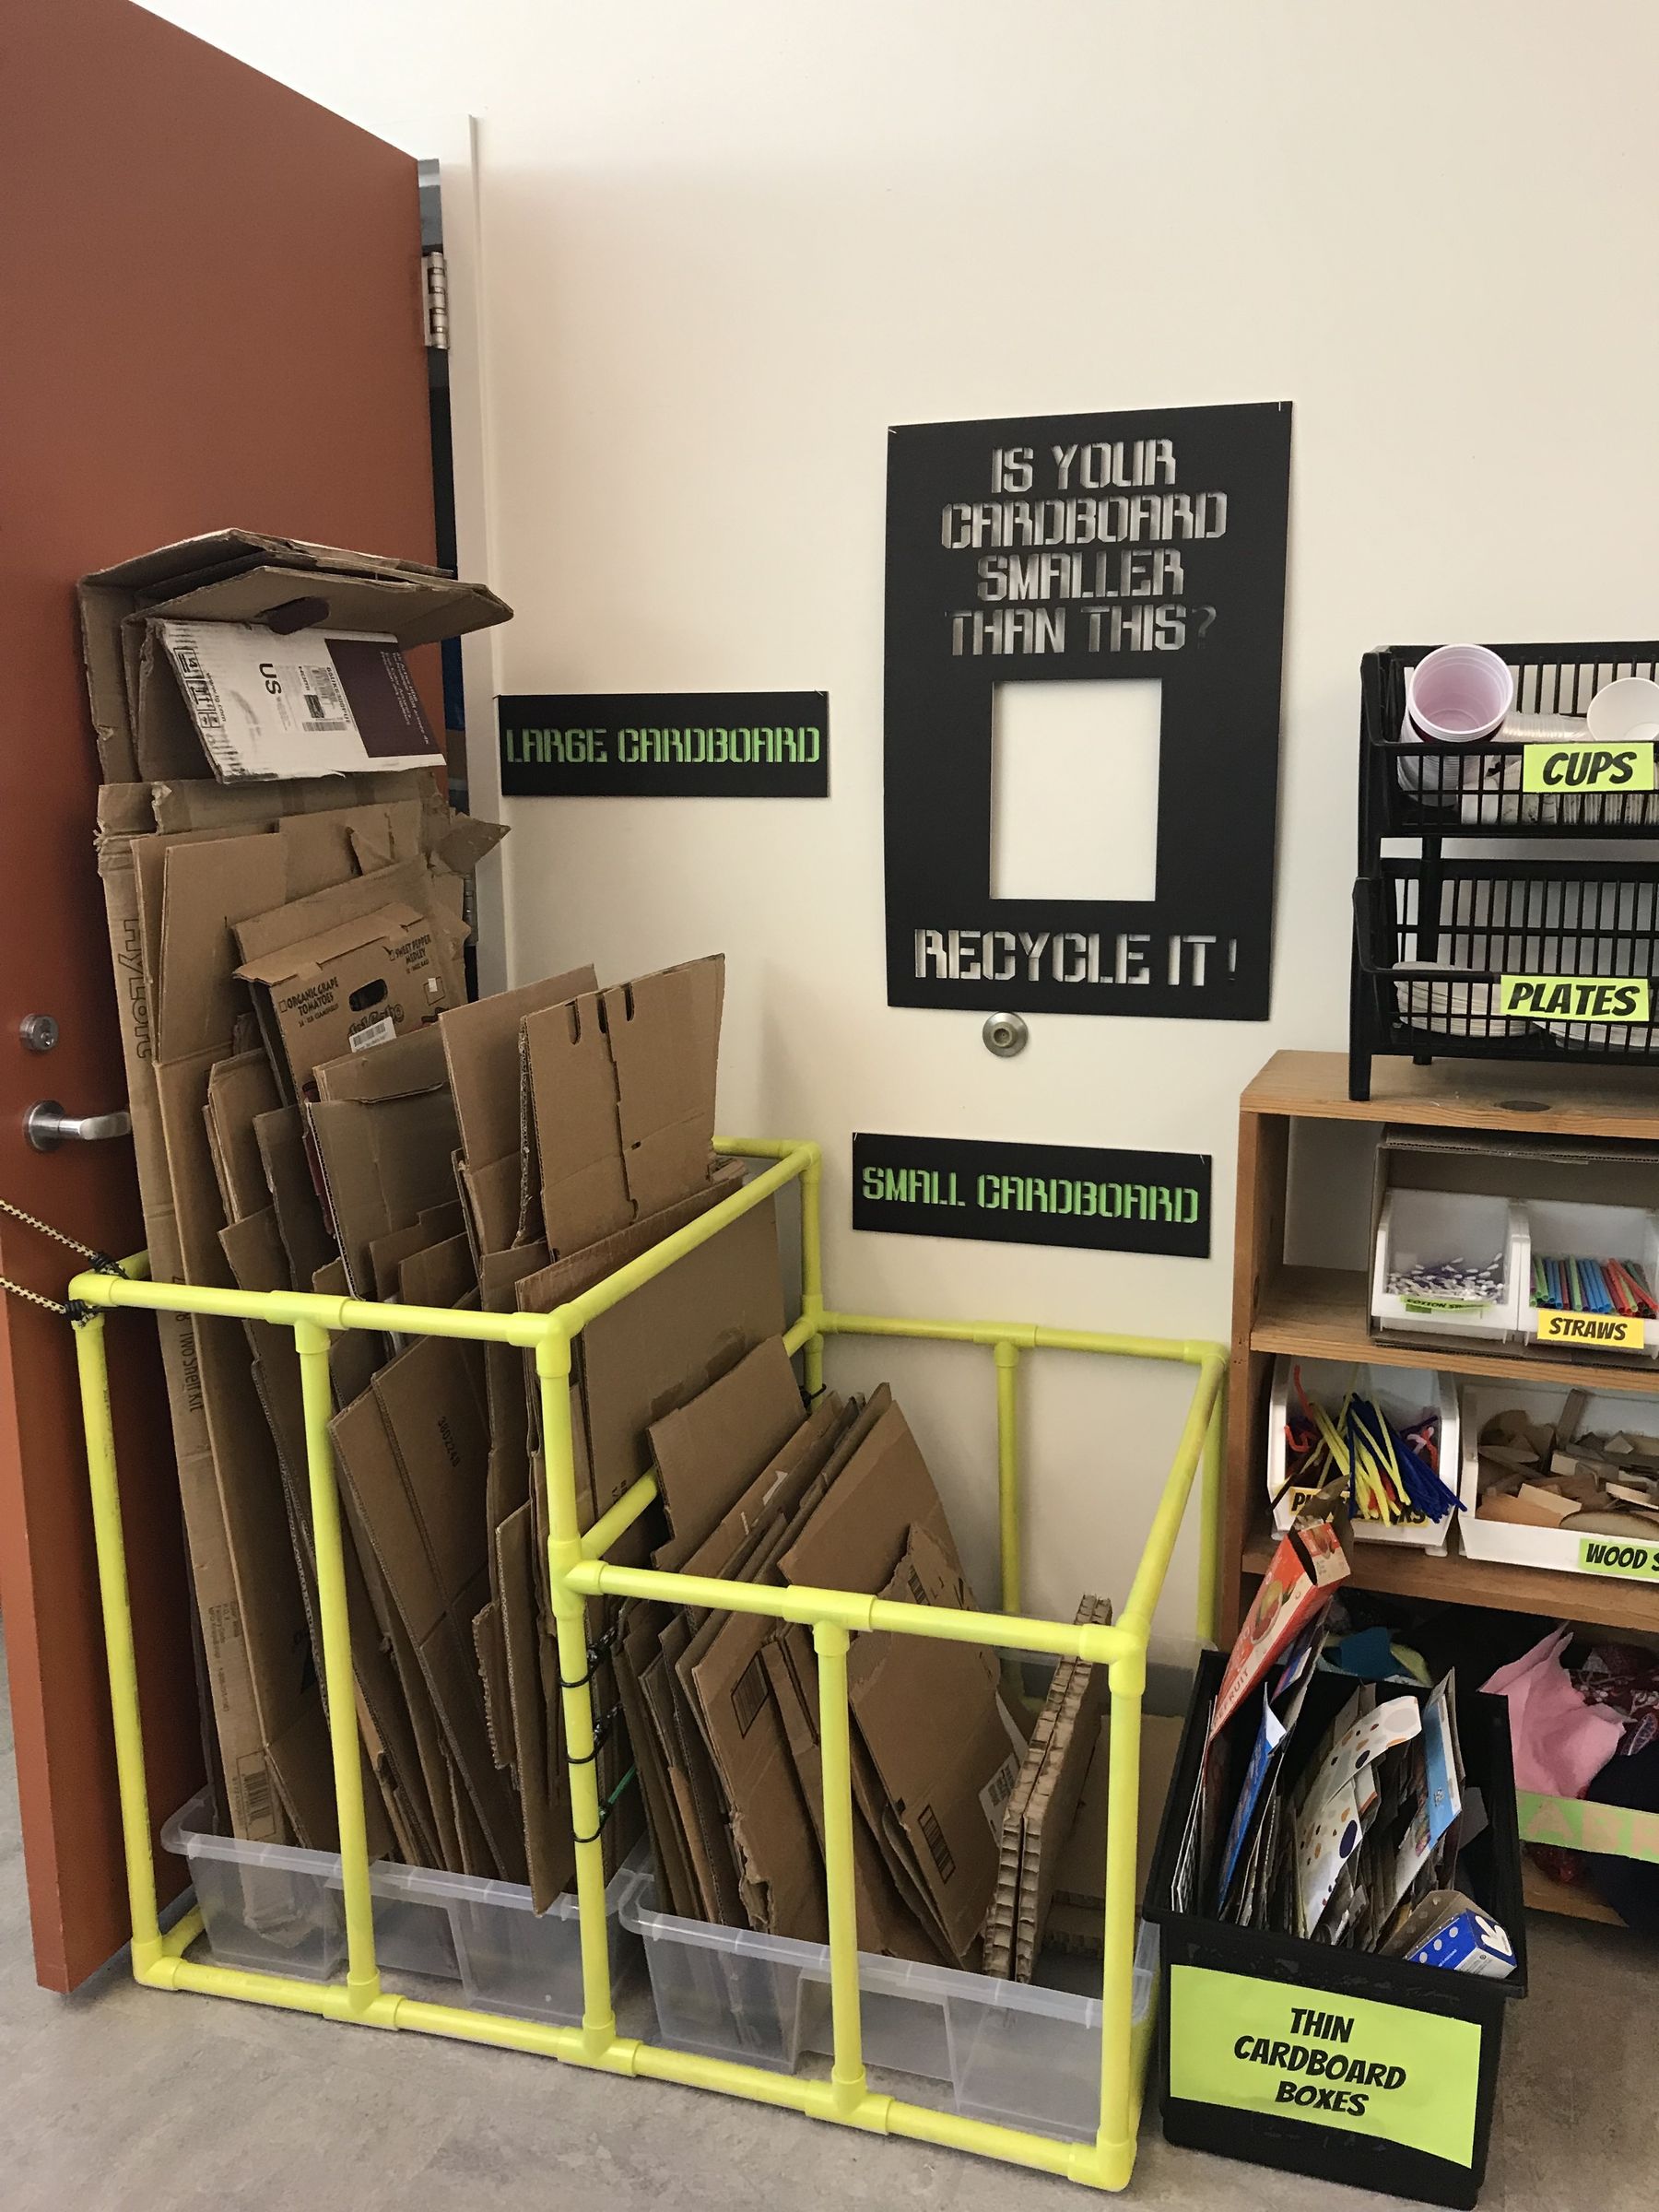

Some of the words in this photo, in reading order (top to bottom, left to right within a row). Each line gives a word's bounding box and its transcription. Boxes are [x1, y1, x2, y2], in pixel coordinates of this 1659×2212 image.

[991, 447, 1033, 493] IS
[1051, 439, 1176, 489] YOUR
[941, 491, 1228, 549] CARDBOARD
[977, 547, 1184, 602] SMALLER
[946, 606, 1066, 656] THAN
[1081, 604, 1218, 653] THIS?
[259, 663, 282, 695] US
[506, 728, 607, 763] LARGE
[618, 726, 820, 763] CARDBOARD
[1542, 750, 1638, 788] CUPS
[394, 941, 412, 959] SWEET
[412, 934, 431, 950] PEPPER
[406, 947, 426, 964] MEDLEY
[914, 929, 1150, 984] RECYCLE
[287, 986, 318, 1008] ORGANIC
[317, 976, 339, 994] GRAPE
[298, 992, 334, 1016] TOMATOES
[1507, 982, 1641, 1017] PLATES
[862, 1166, 966, 1206] SMALL
[977, 1173, 1199, 1224] CARDBOARD
[1548, 1316, 1628, 1341] STRAWS
[1585, 1543, 1648, 1570] WOOD
[1289, 2007, 1355, 2043] THIN
[1233, 2035, 1406, 2090] CARDBOARD
[1274, 2081, 1370, 2117] BOXES
